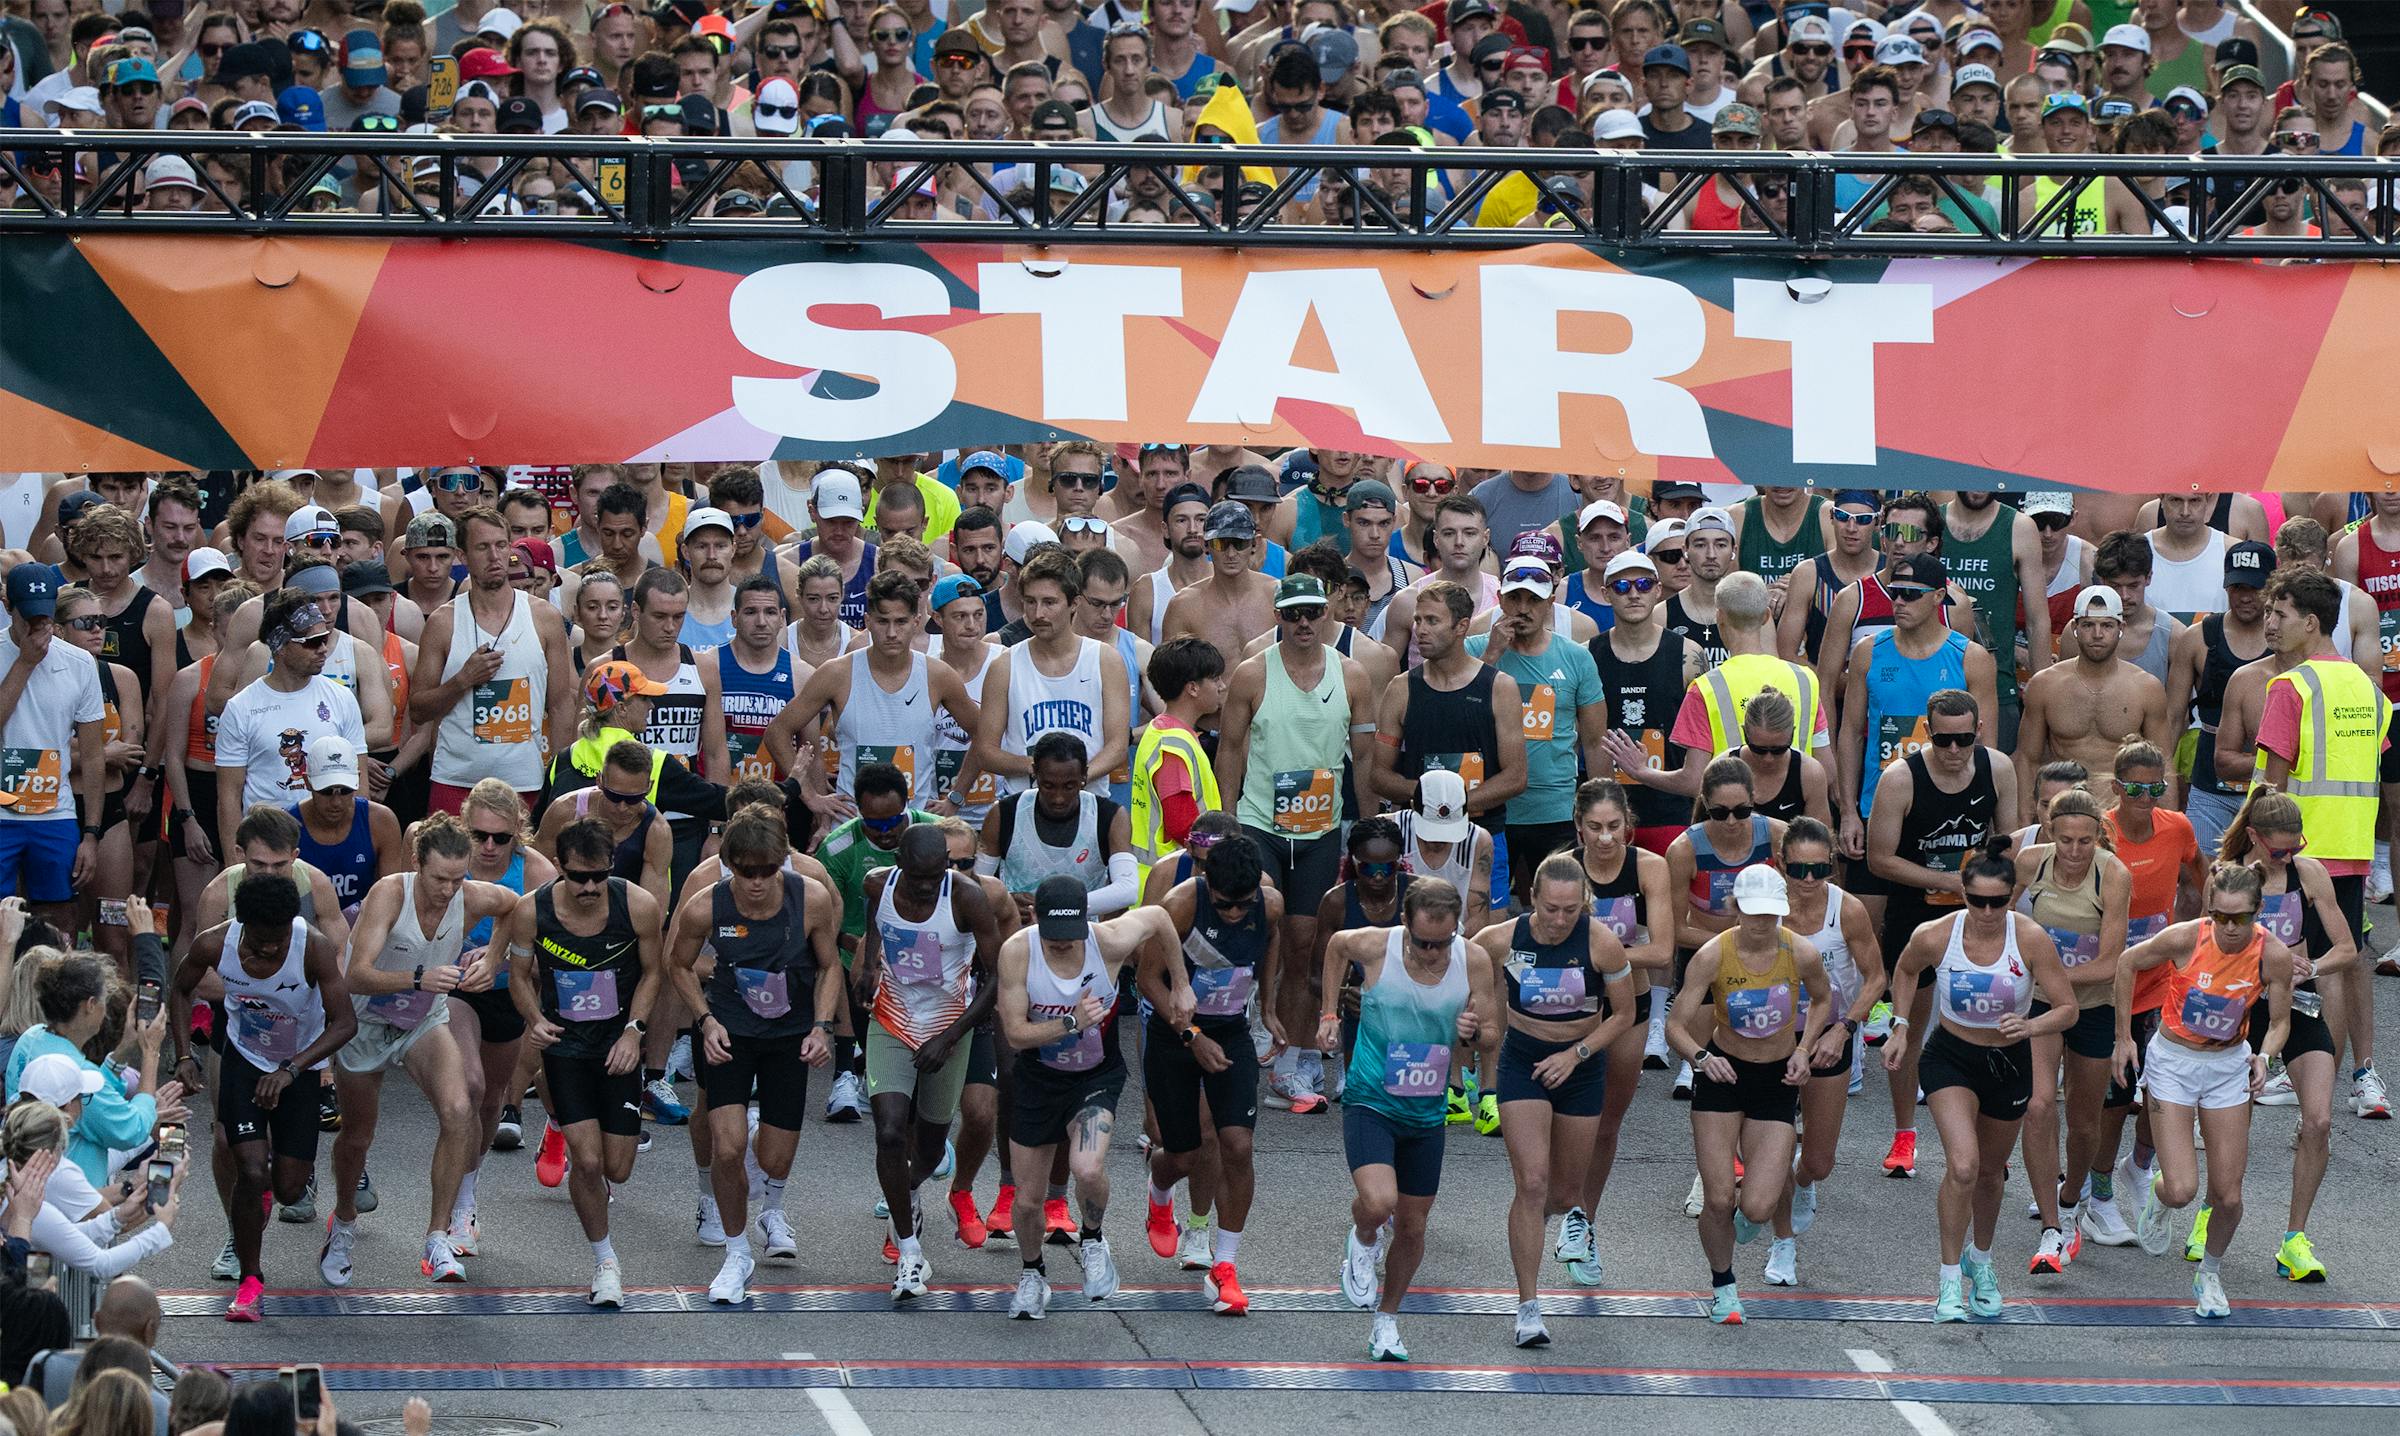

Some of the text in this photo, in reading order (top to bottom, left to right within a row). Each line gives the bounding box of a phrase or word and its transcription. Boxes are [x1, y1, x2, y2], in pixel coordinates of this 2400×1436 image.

[1962, 69, 1992, 81] ciele
[730, 261, 1936, 467] START
[1760, 556, 1774, 569] EL
[1957, 559, 1988, 571] JEFE
[2232, 551, 2260, 568] USA
[839, 604, 865, 617] CITY
[1620, 686, 1648, 694] BANDIT
[724, 696, 787, 715] RUNNING
[475, 704, 530, 724] 3968
[658, 708, 703, 725] CITIES
[734, 715, 774, 726] NEBRAS
[1022, 699, 1093, 742] LUTHER
[1522, 710, 1552, 729] 69
[744, 752, 758, 760] TOM
[4, 775, 58, 793] 1782
[1276, 794, 1331, 814] 3802
[1048, 908, 1081, 917] SAUCONY
[541, 937, 588, 966] WAYZATA
[897, 950, 925, 969] 25
[1726, 977, 1747, 987] ZAP
[571, 995, 601, 1011] 23
[1206, 992, 1231, 1007] 11
[1961, 998, 2005, 1014] 105
[1031, 1003, 1074, 1018] FITN
[1740, 1010, 1783, 1031] 103
[2192, 1011, 2236, 1033] 107
[1056, 1050, 1084, 1065] 51
[1395, 1069, 1438, 1088] 100
